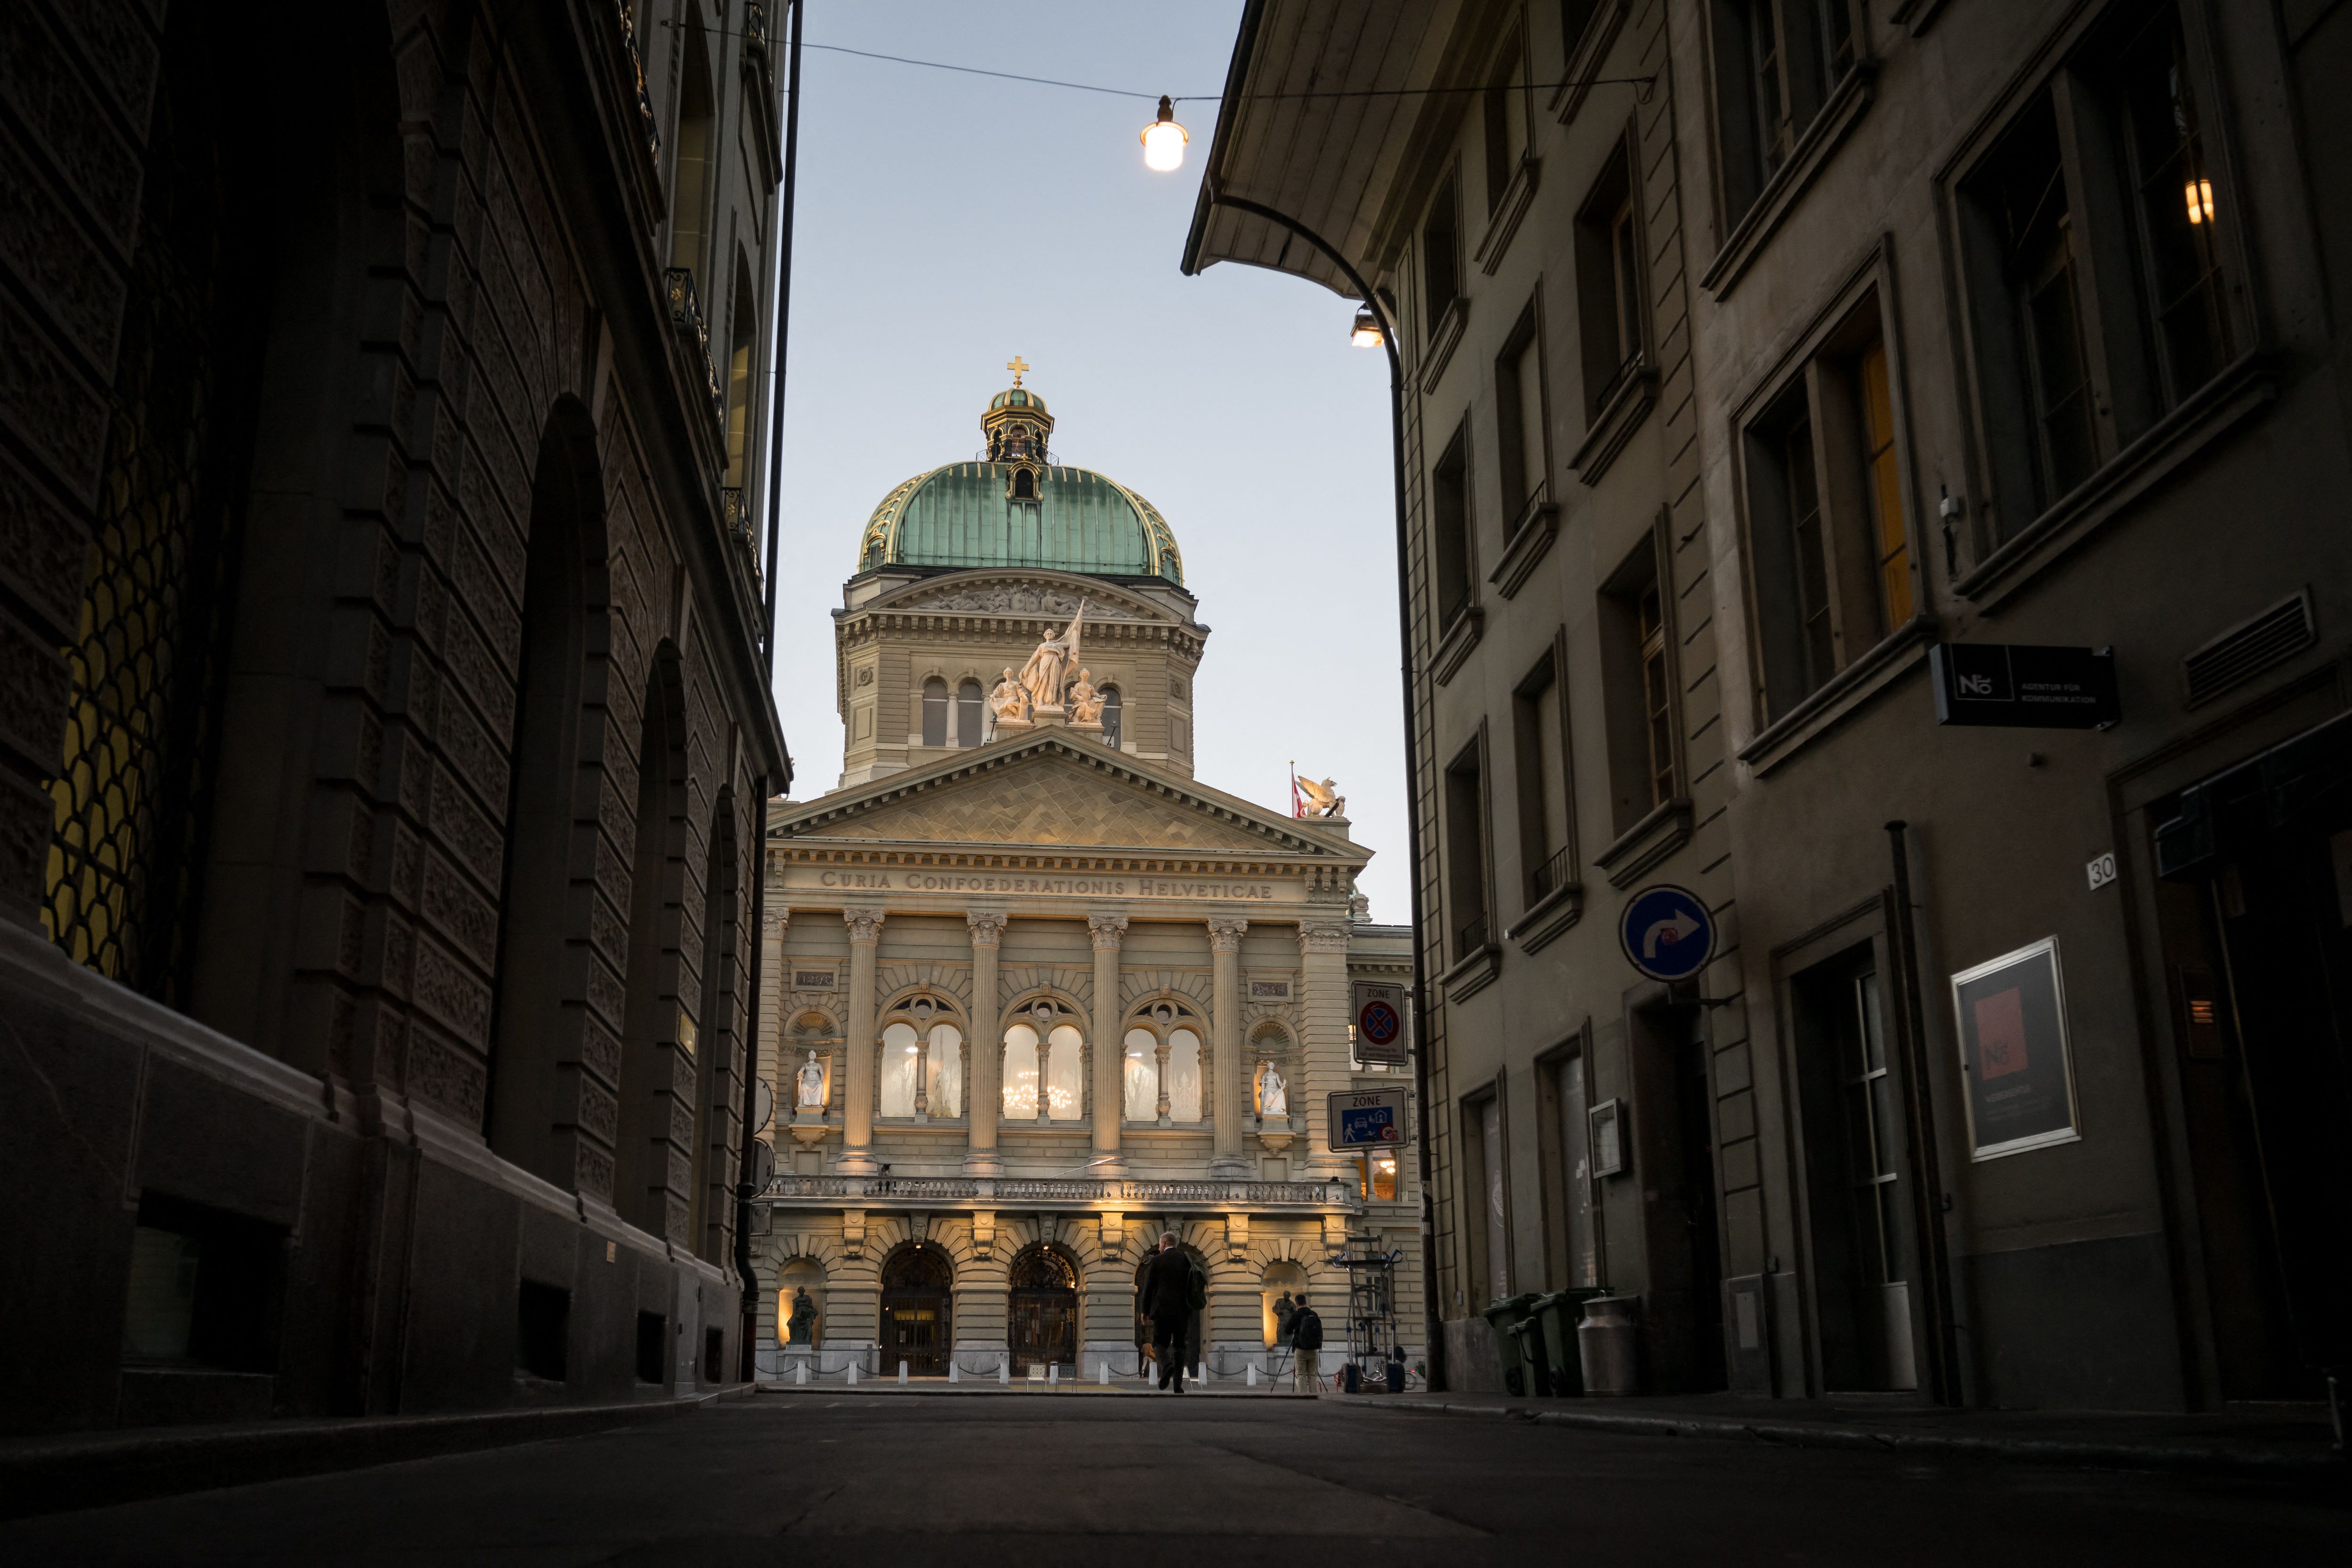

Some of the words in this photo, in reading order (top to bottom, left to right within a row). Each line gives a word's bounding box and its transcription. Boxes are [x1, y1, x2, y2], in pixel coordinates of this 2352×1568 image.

[2021, 683, 2062, 692] AGENTUR
[2064, 683, 2082, 692] FÜR
[2021, 695, 2097, 704] KOMMUNIKATION
[2091, 857, 2114, 883] 30
[820, 871, 890, 888] CURIA
[906, 874, 1124, 894] CONFOEDERATIONIS
[1139, 880, 1272, 899] HELVETICAE
[1367, 989, 1390, 998] ZONE
[1353, 1096, 1381, 1107] ZONE
